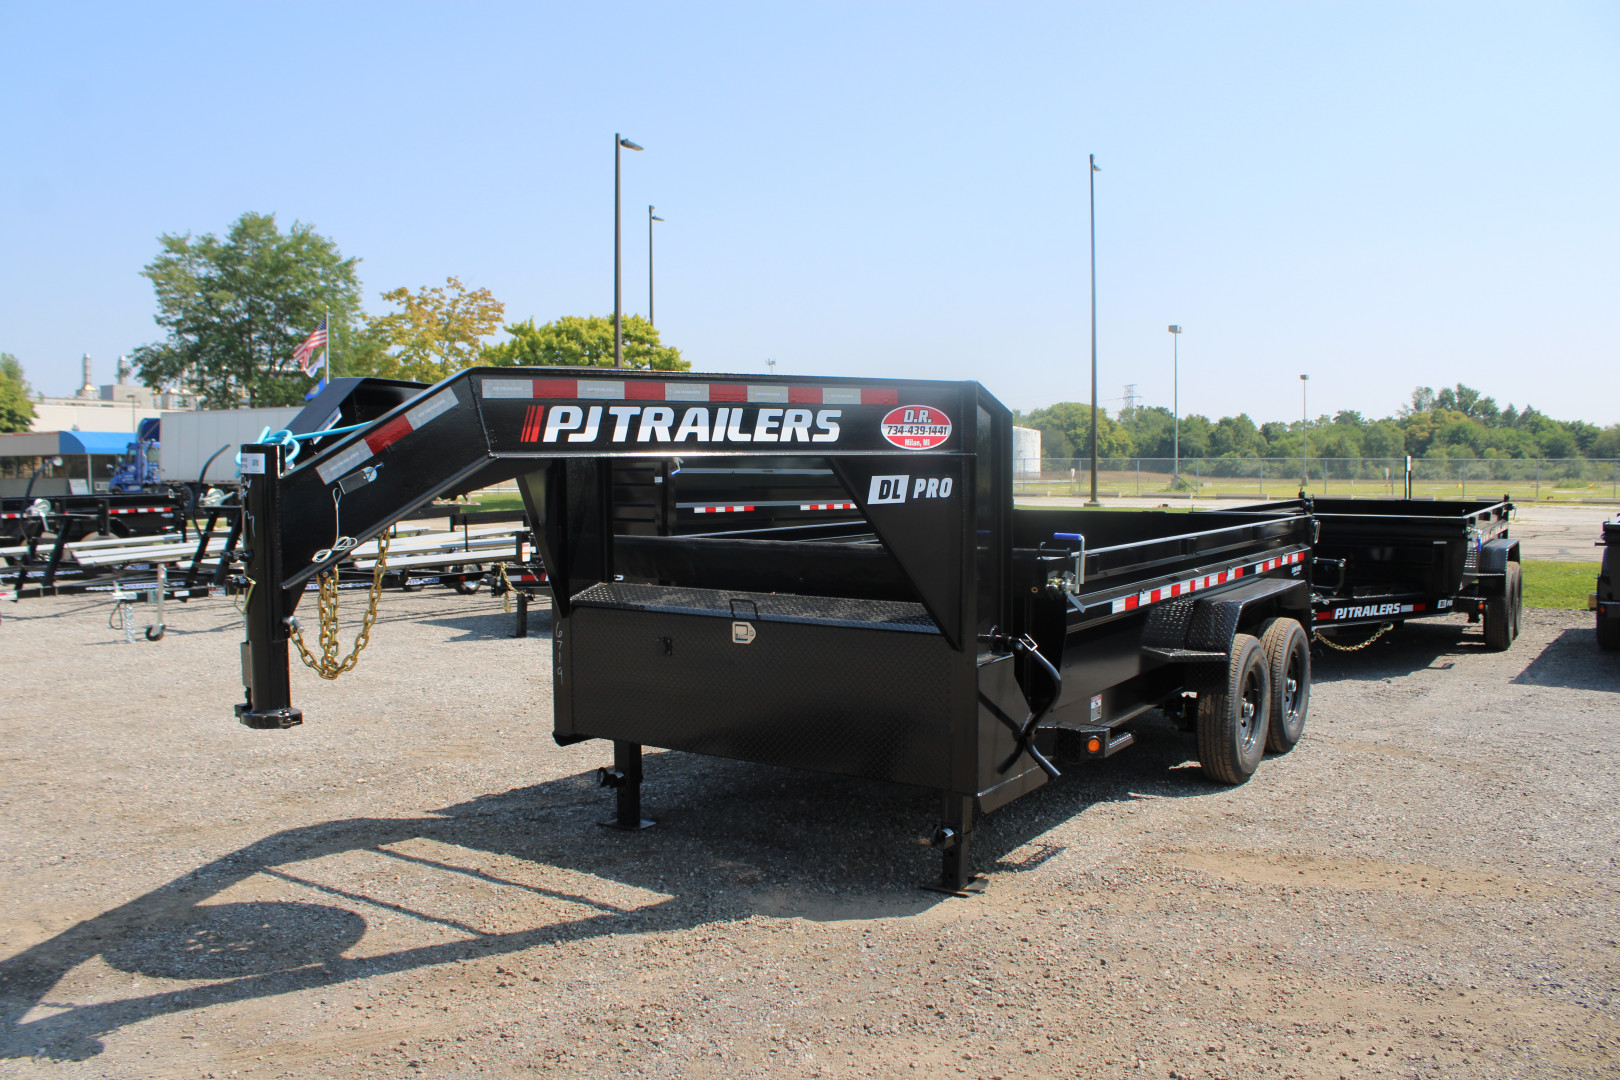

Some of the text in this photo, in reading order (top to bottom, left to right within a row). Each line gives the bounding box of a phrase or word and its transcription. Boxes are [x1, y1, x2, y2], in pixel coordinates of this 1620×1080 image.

[903, 409, 932, 423] D.R.
[542, 405, 842, 443] PJ TRAILERS
[887, 425, 947, 435] 734-439-1441
[904, 438, 930, 447] Milan, MI
[878, 477, 953, 499] DL PRO
[1348, 603, 1401, 618] TRAILERS
